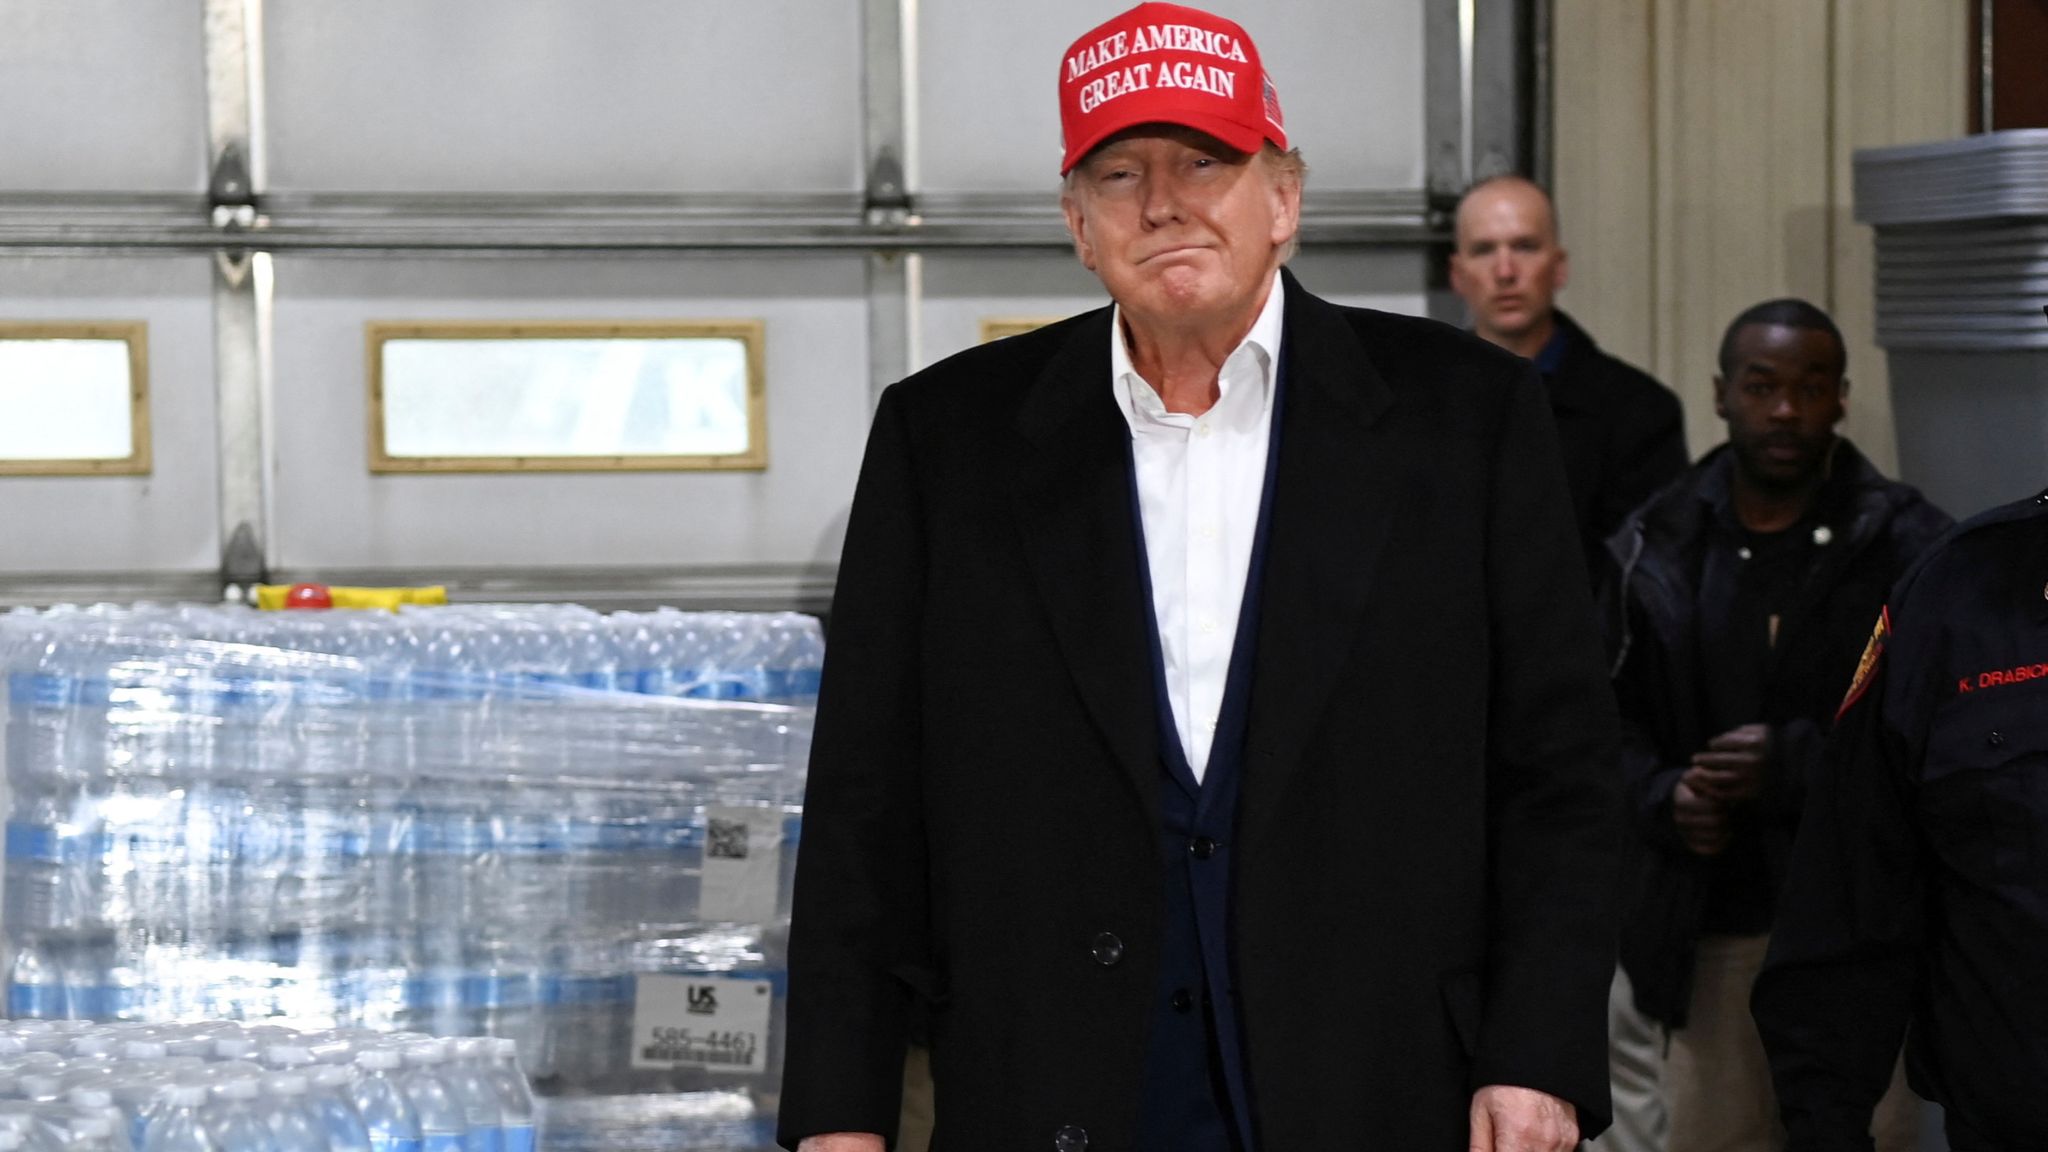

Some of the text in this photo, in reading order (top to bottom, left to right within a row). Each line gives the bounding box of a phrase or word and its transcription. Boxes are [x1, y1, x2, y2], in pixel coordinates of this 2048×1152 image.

[1066, 24, 1248, 83] MAKE AMERICA
[1080, 61, 1236, 113] GREAT AGAIN
[1959, 678, 1974, 693] K.
